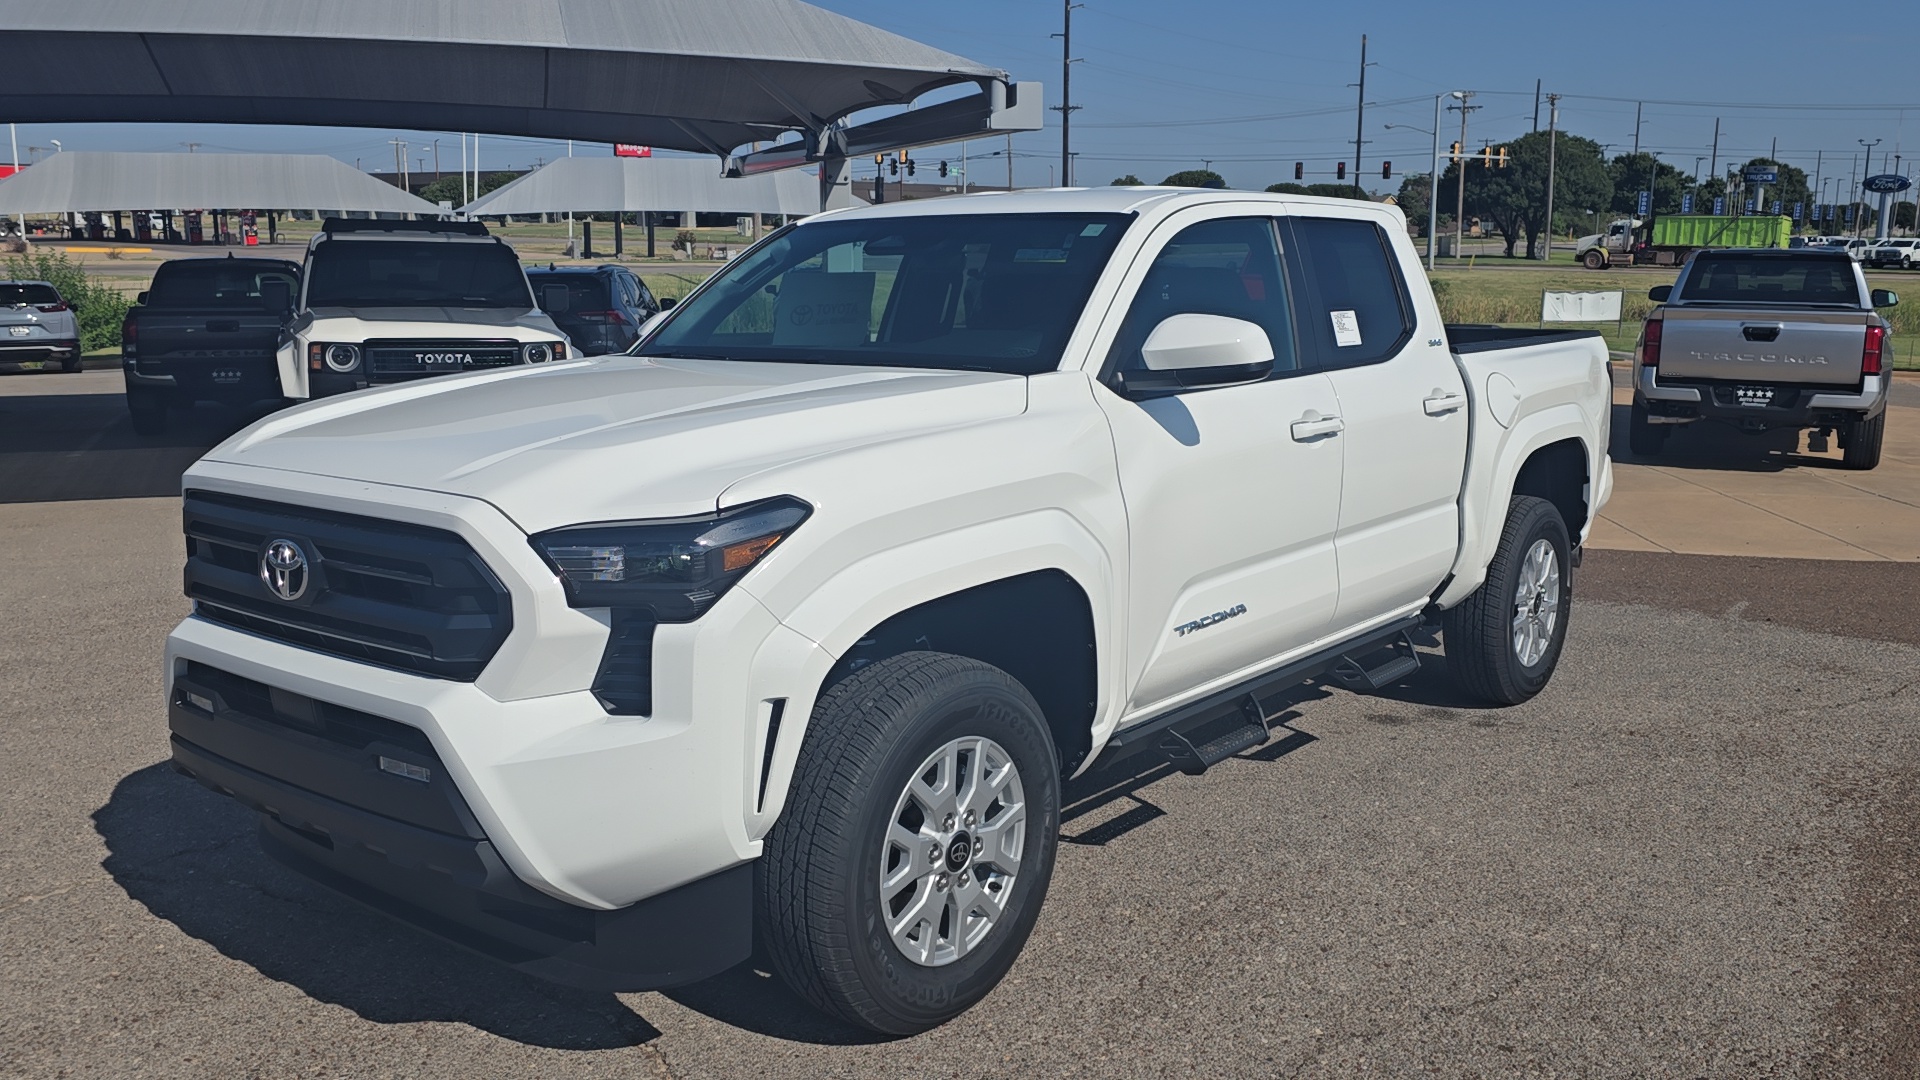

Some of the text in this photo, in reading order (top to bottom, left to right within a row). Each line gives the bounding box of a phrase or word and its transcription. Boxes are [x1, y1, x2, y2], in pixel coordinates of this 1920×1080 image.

[1746, 173, 1773, 181] TRUCKS
[1872, 177, 1901, 190] Ford
[816, 303, 859, 316] TOYOTA
[415, 353, 473, 364] TOYOTA
[1690, 351, 1829, 365] TACOMA
[1173, 603, 1247, 637] TACOMA
